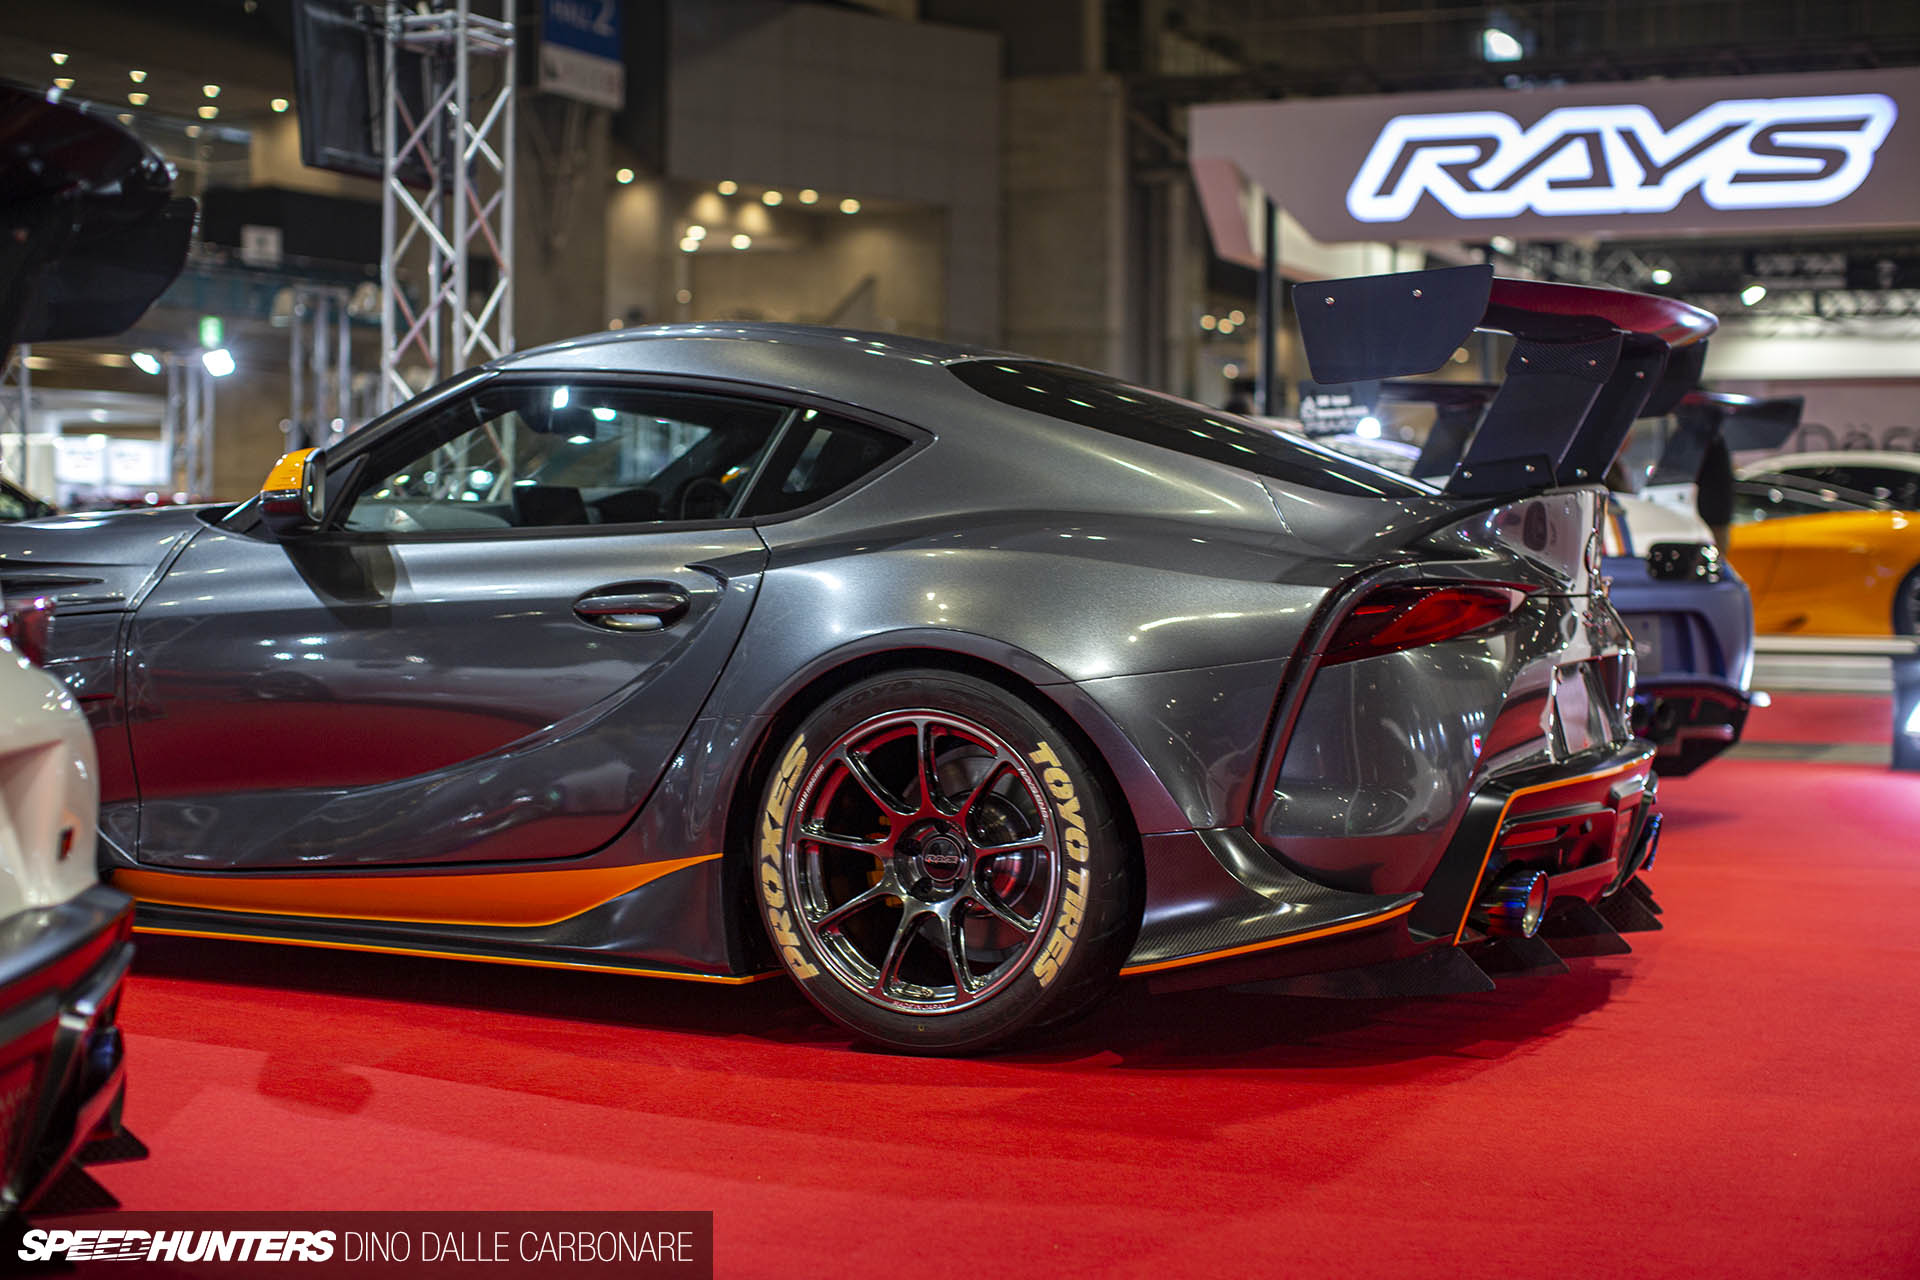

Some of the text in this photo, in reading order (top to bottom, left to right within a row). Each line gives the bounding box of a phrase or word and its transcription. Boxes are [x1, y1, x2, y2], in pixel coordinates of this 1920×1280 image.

[1348, 94, 1898, 222] RAYS
[761, 733, 820, 980] PROXES
[1028, 741, 1091, 989] TOYO TIRES
